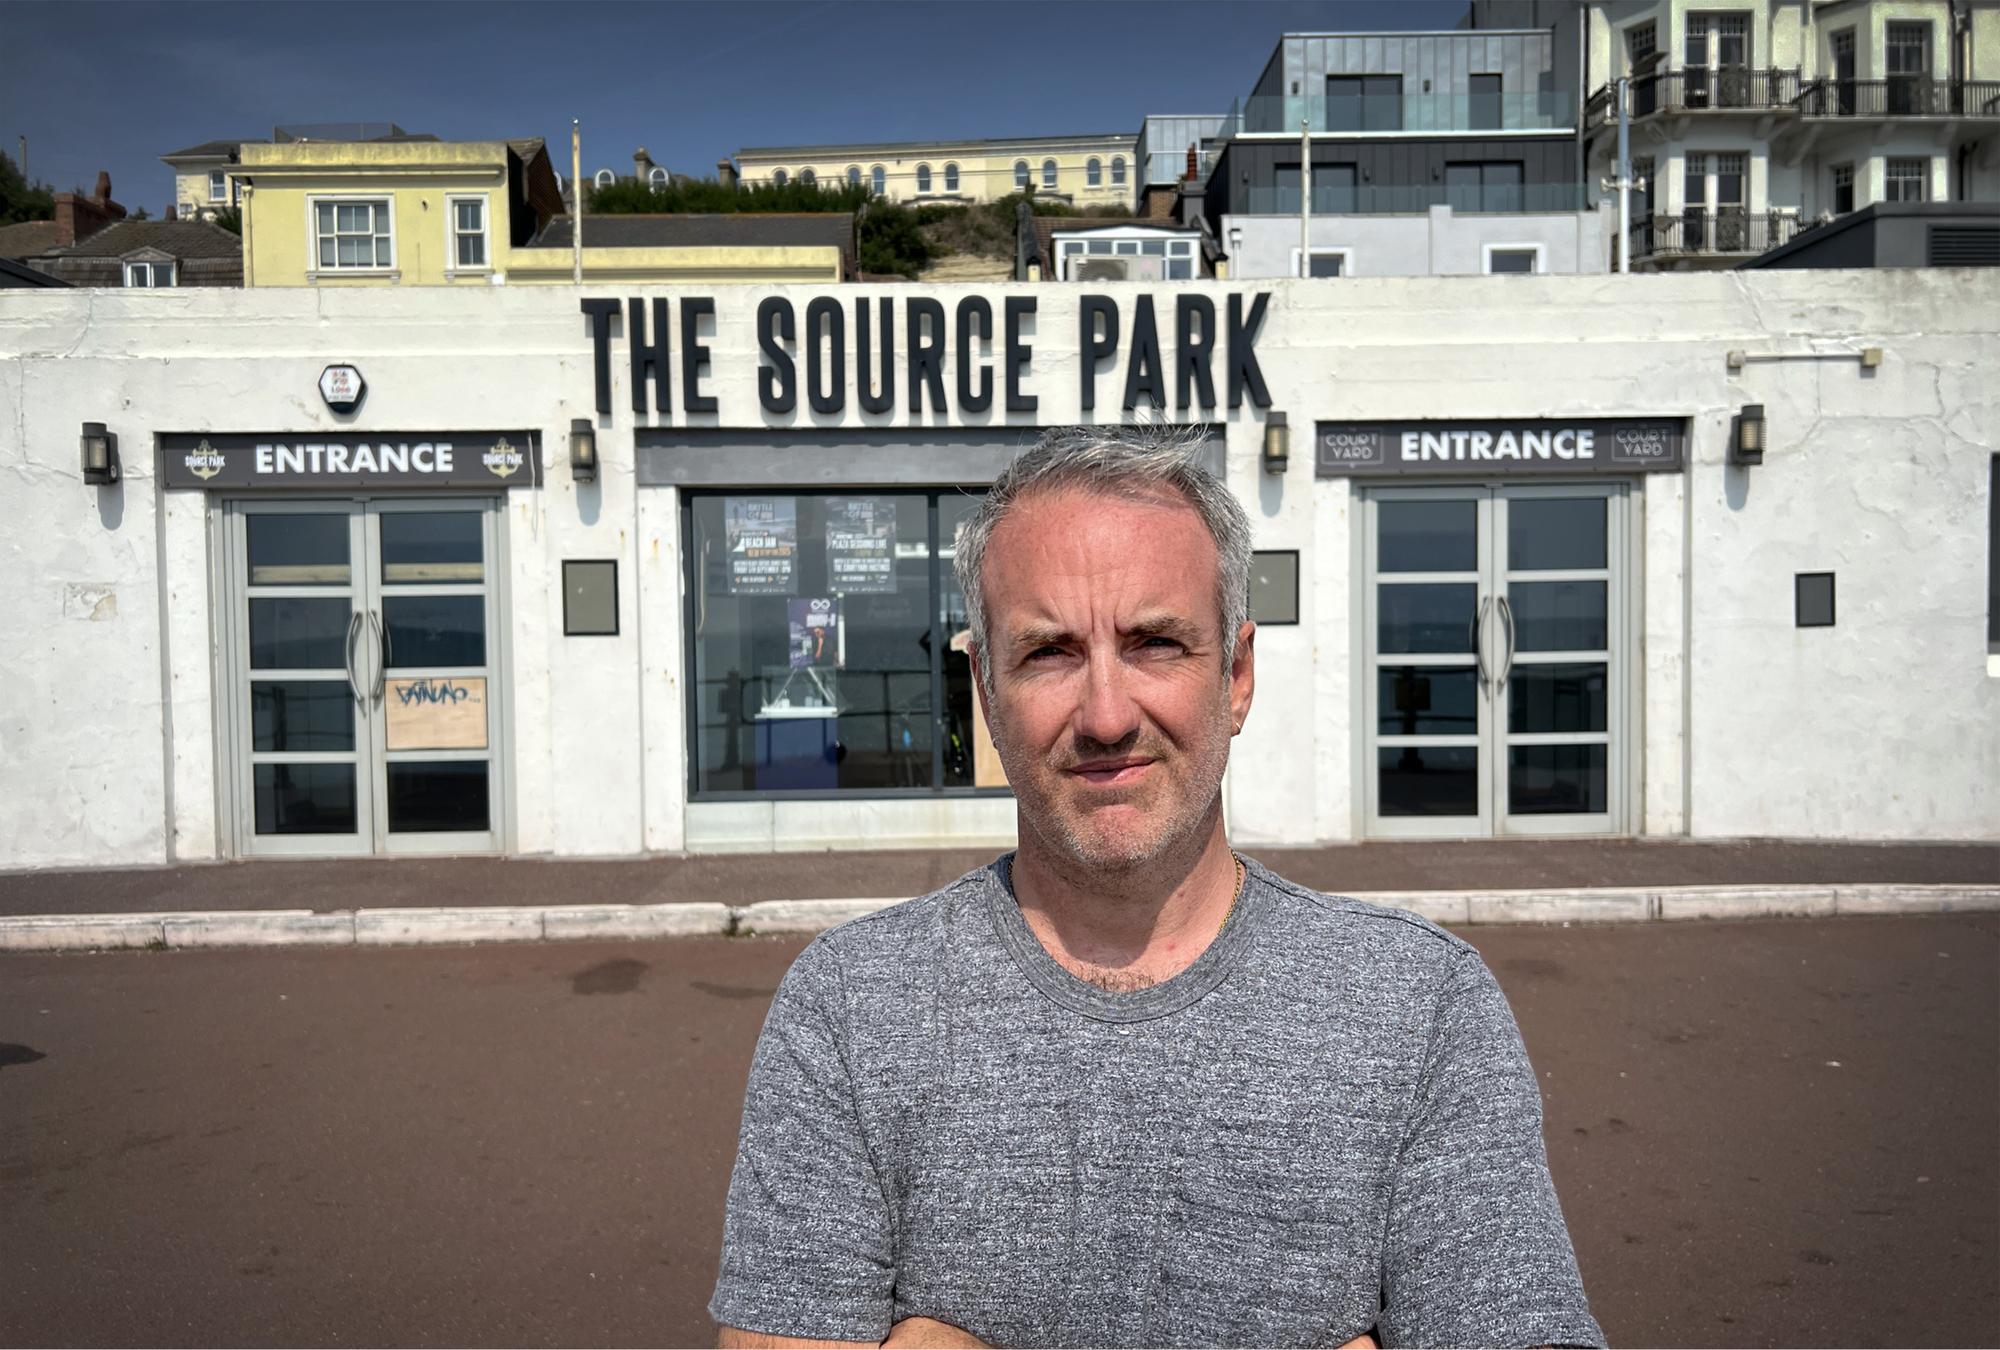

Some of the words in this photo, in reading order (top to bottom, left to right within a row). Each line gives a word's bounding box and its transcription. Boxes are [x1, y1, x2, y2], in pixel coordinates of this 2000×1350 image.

[580, 297, 719, 416] THE
[757, 296, 1038, 415] SOURCE
[1080, 292, 1273, 412] PARK
[1325, 433, 1378, 446] COURT
[1616, 429, 1669, 443] COURT
[1400, 430, 1595, 461] ENTRANCE
[1623, 443, 1664, 456] YARD
[255, 443, 455, 474] ENTRANCE
[482, 454, 505, 465] SOURCE
[506, 453, 523, 464] PARK
[1332, 447, 1373, 459] YARD
[185, 455, 208, 467] SOURCE
[209, 455, 226, 466] PARK
